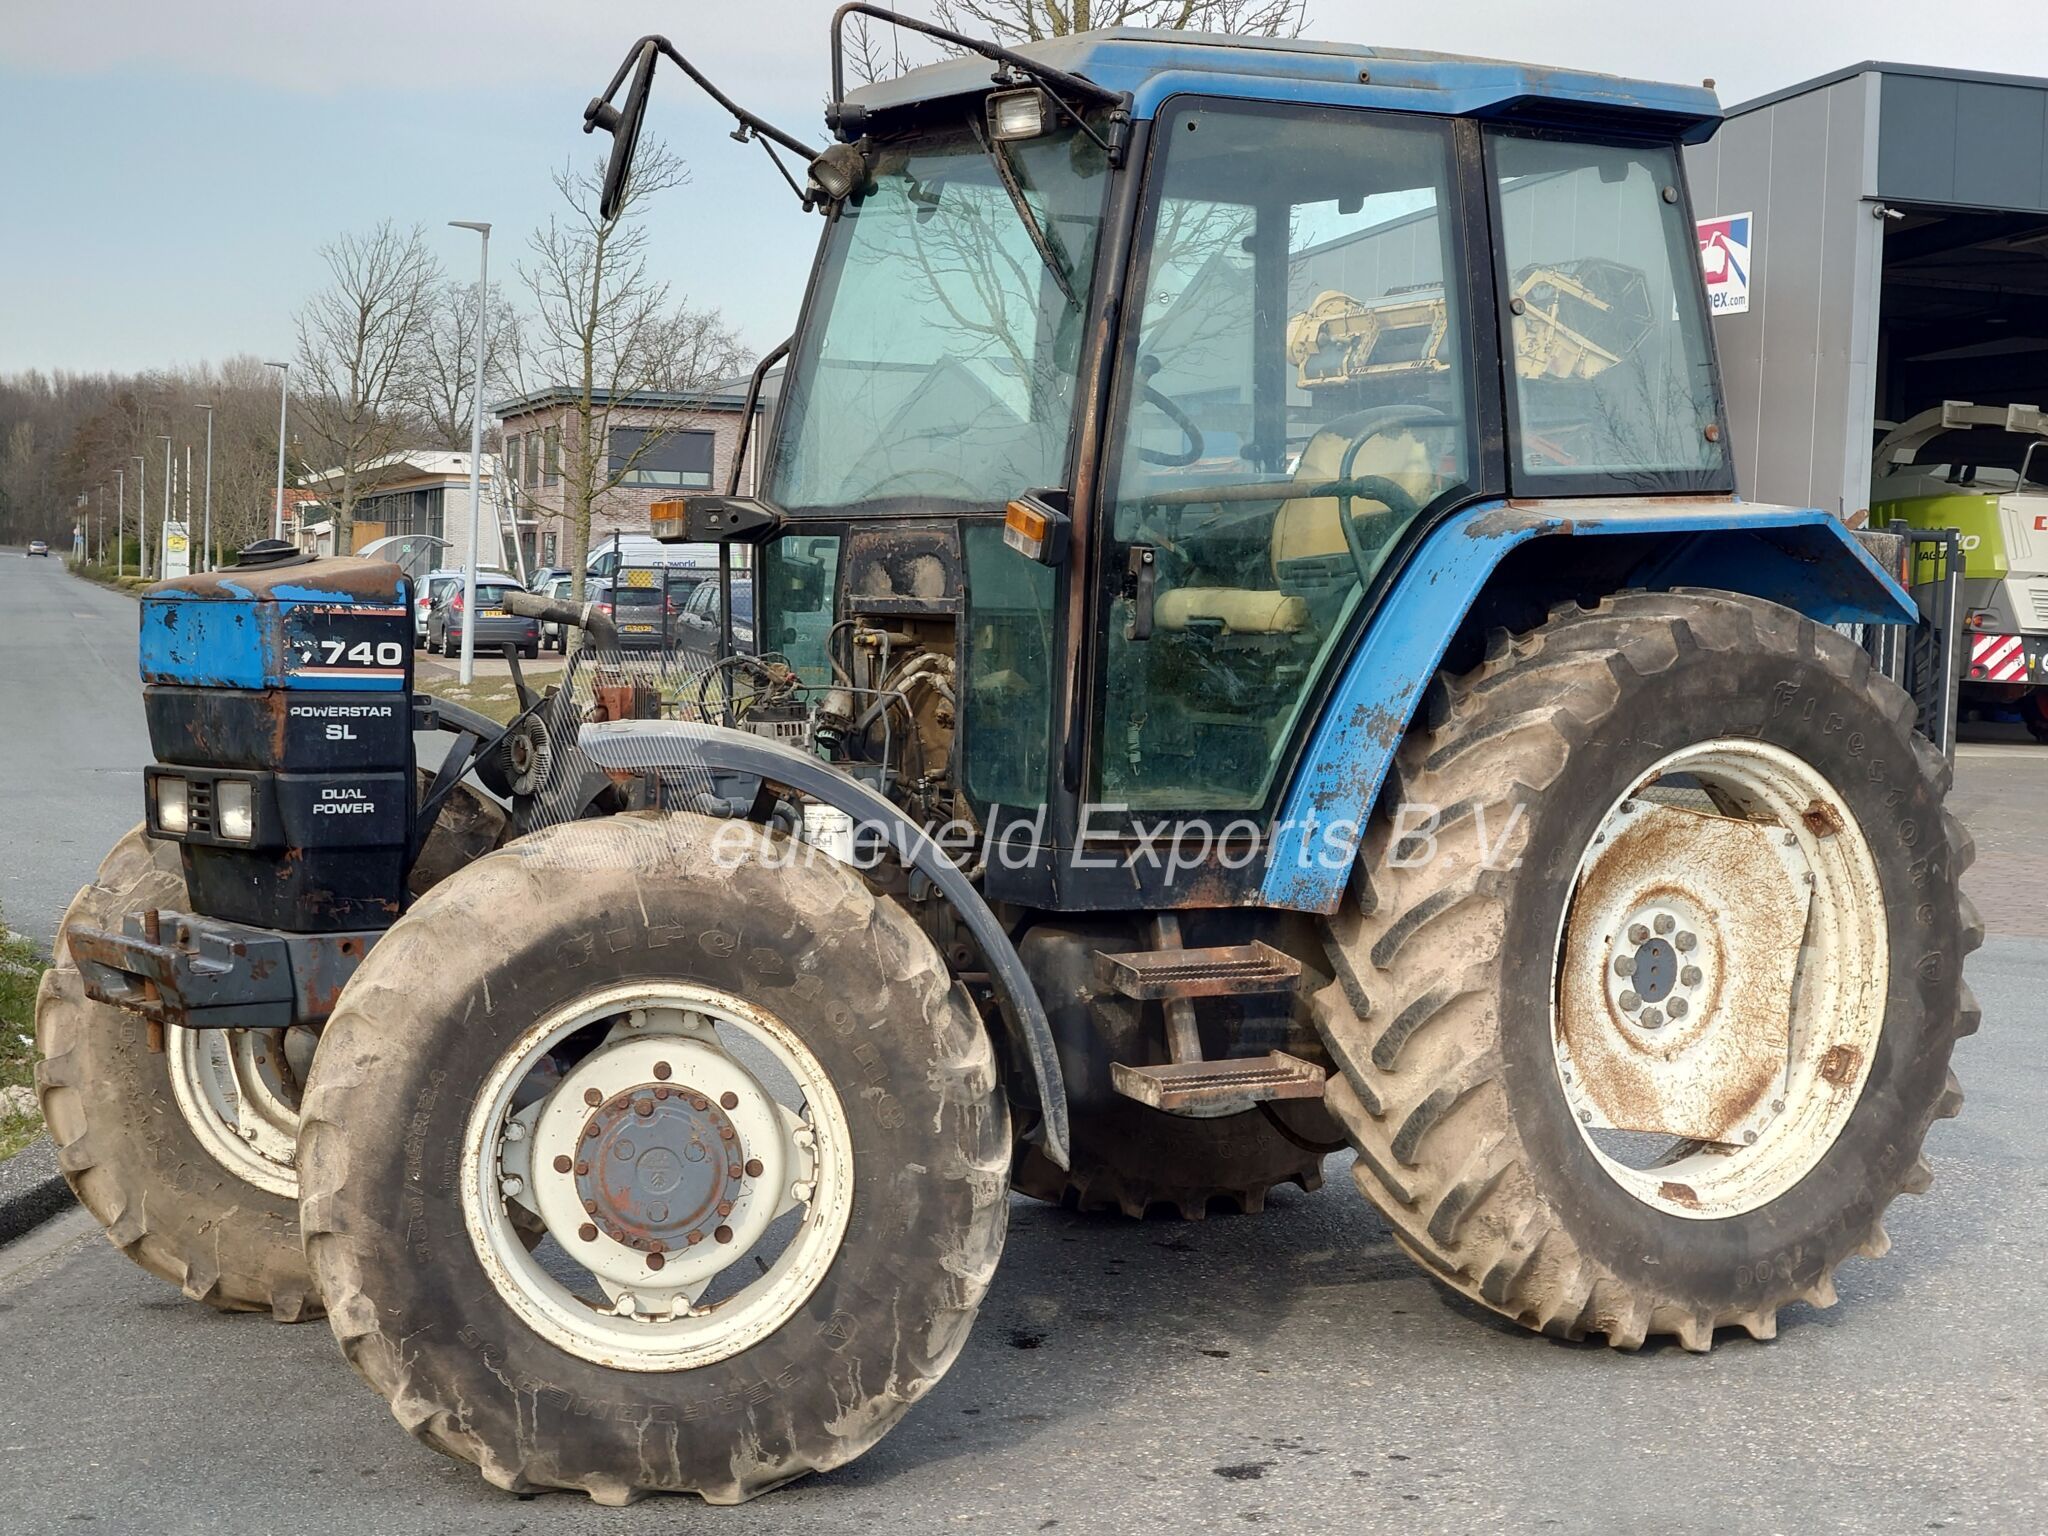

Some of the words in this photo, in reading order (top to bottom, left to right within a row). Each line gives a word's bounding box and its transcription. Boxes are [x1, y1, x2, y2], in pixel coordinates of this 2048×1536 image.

[290, 705, 392, 718] POWERSTAR
[325, 724, 358, 741] SL
[321, 788, 367, 800] DUAL
[312, 802, 375, 815] POWER
